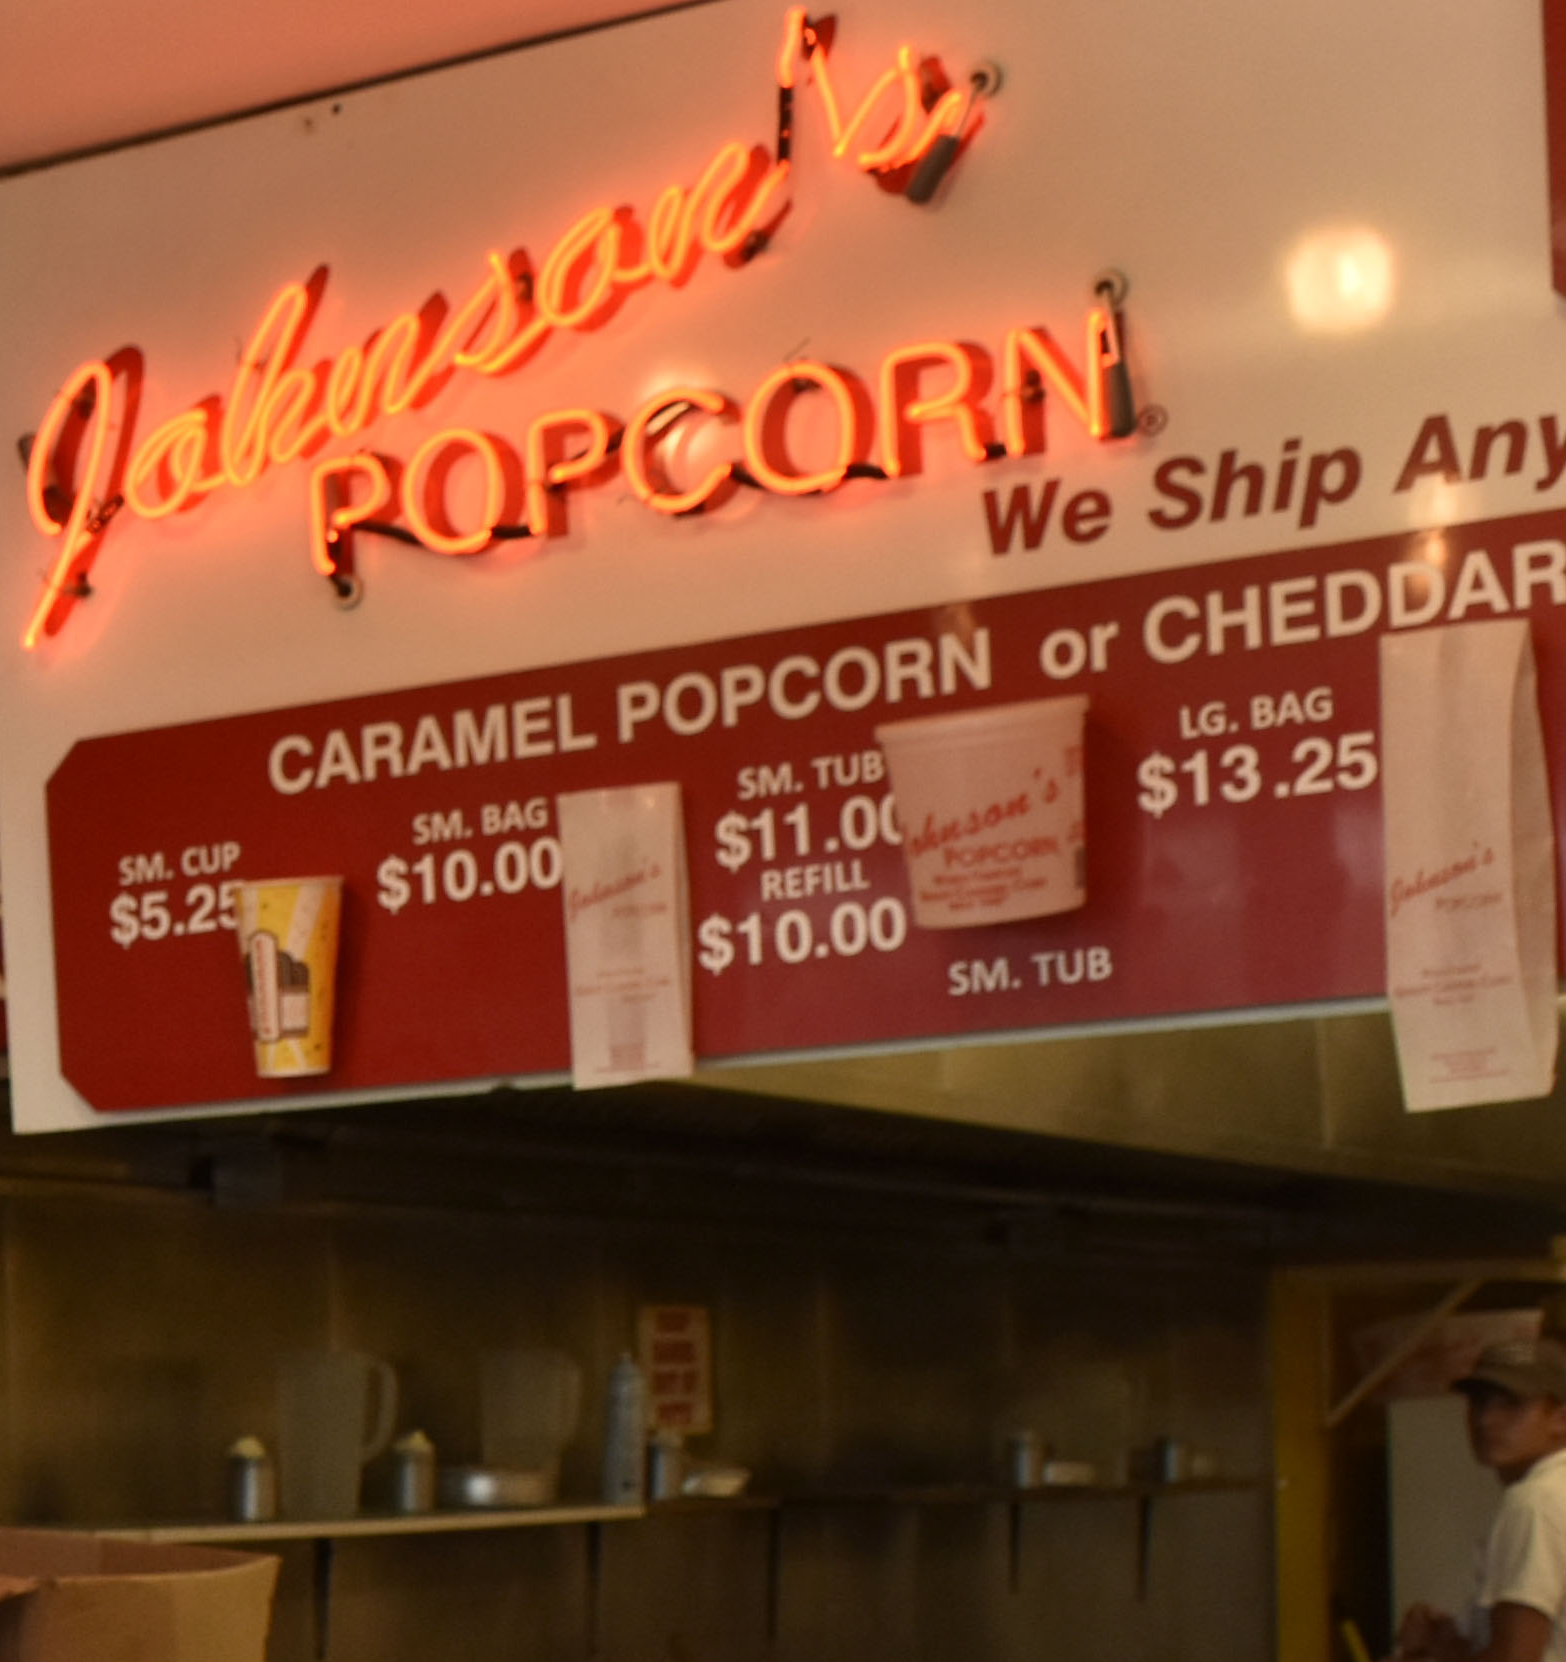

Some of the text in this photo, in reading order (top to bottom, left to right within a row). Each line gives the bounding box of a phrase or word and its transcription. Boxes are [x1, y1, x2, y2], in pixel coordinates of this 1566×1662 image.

[23, 6, 985, 652] Johnson's
[309, 306, 1127, 582] POPCORN
[981, 412, 1566, 557] We Ship Any
[269, 537, 1566, 796] CARAMEL POPCORN or CHEDDAR
[1179, 687, 1334, 740] LG. BAG
[738, 750, 885, 800] SM. TUB
[1137, 731, 1379, 819] $13.25
[412, 797, 549, 845] SM. BAG
[714, 794, 904, 872] $11.00
[118, 841, 242, 888] SM. CUP
[376, 837, 564, 914] $10.00
[760, 859, 870, 902] REFILL
[109, 879, 244, 948] $5.25
[698, 897, 908, 974] $10.00
[948, 946, 1113, 997] SM. TUB
